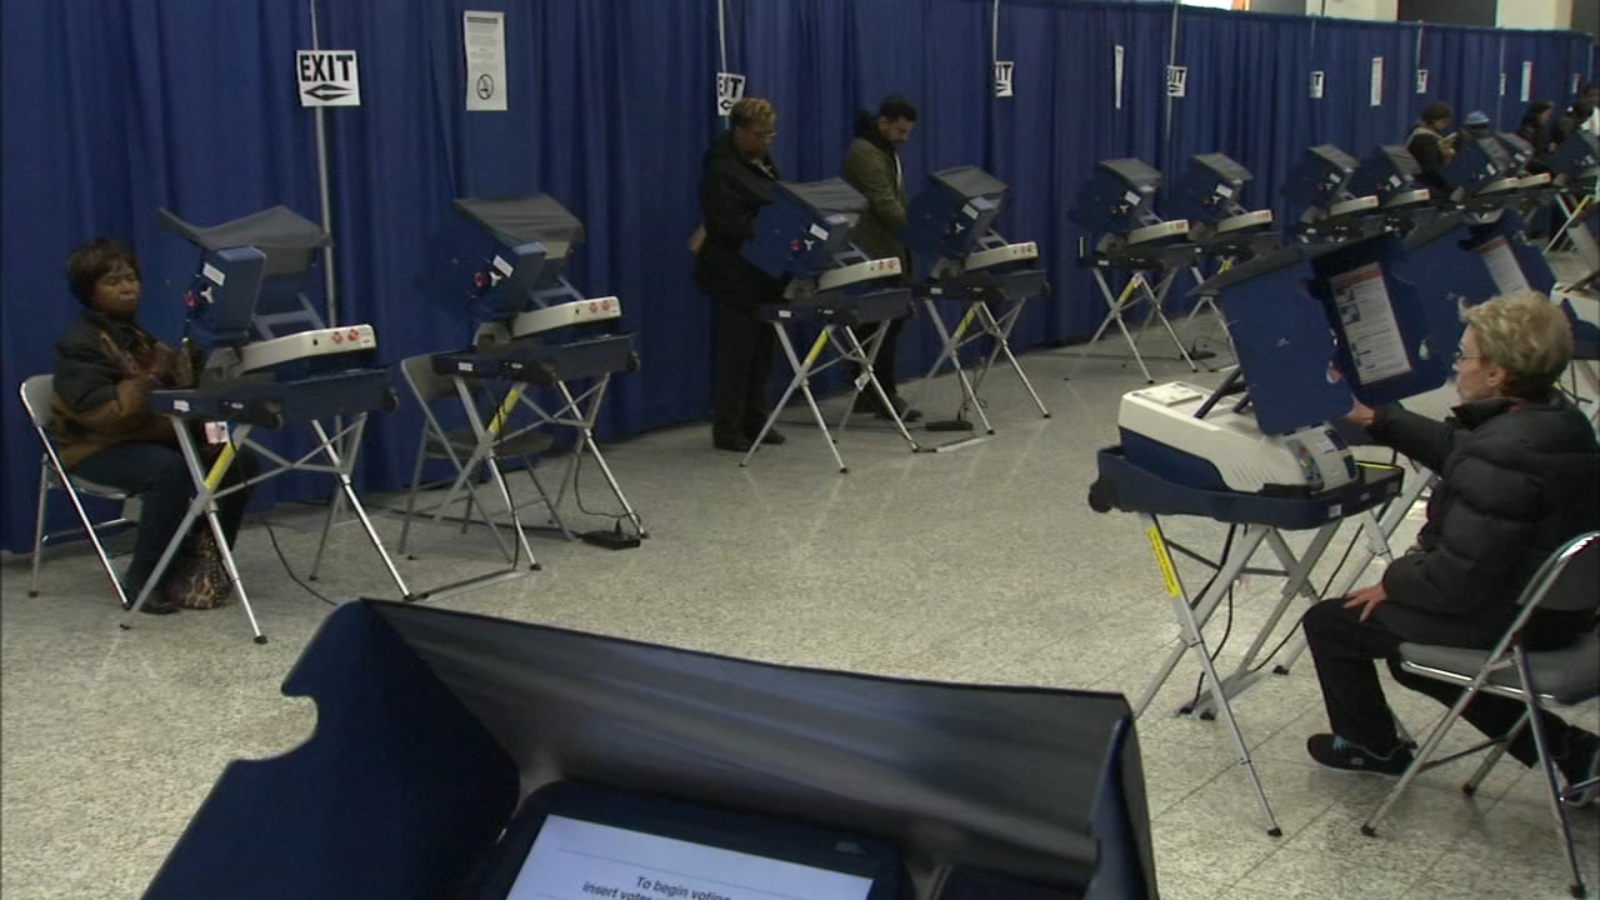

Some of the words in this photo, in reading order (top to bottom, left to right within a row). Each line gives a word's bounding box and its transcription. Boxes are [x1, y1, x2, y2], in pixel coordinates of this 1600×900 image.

[300, 54, 354, 82] EXIT
[582, 880, 618, 898] insert
[636, 876, 652, 890] To
[653, 880, 689, 897] begin
